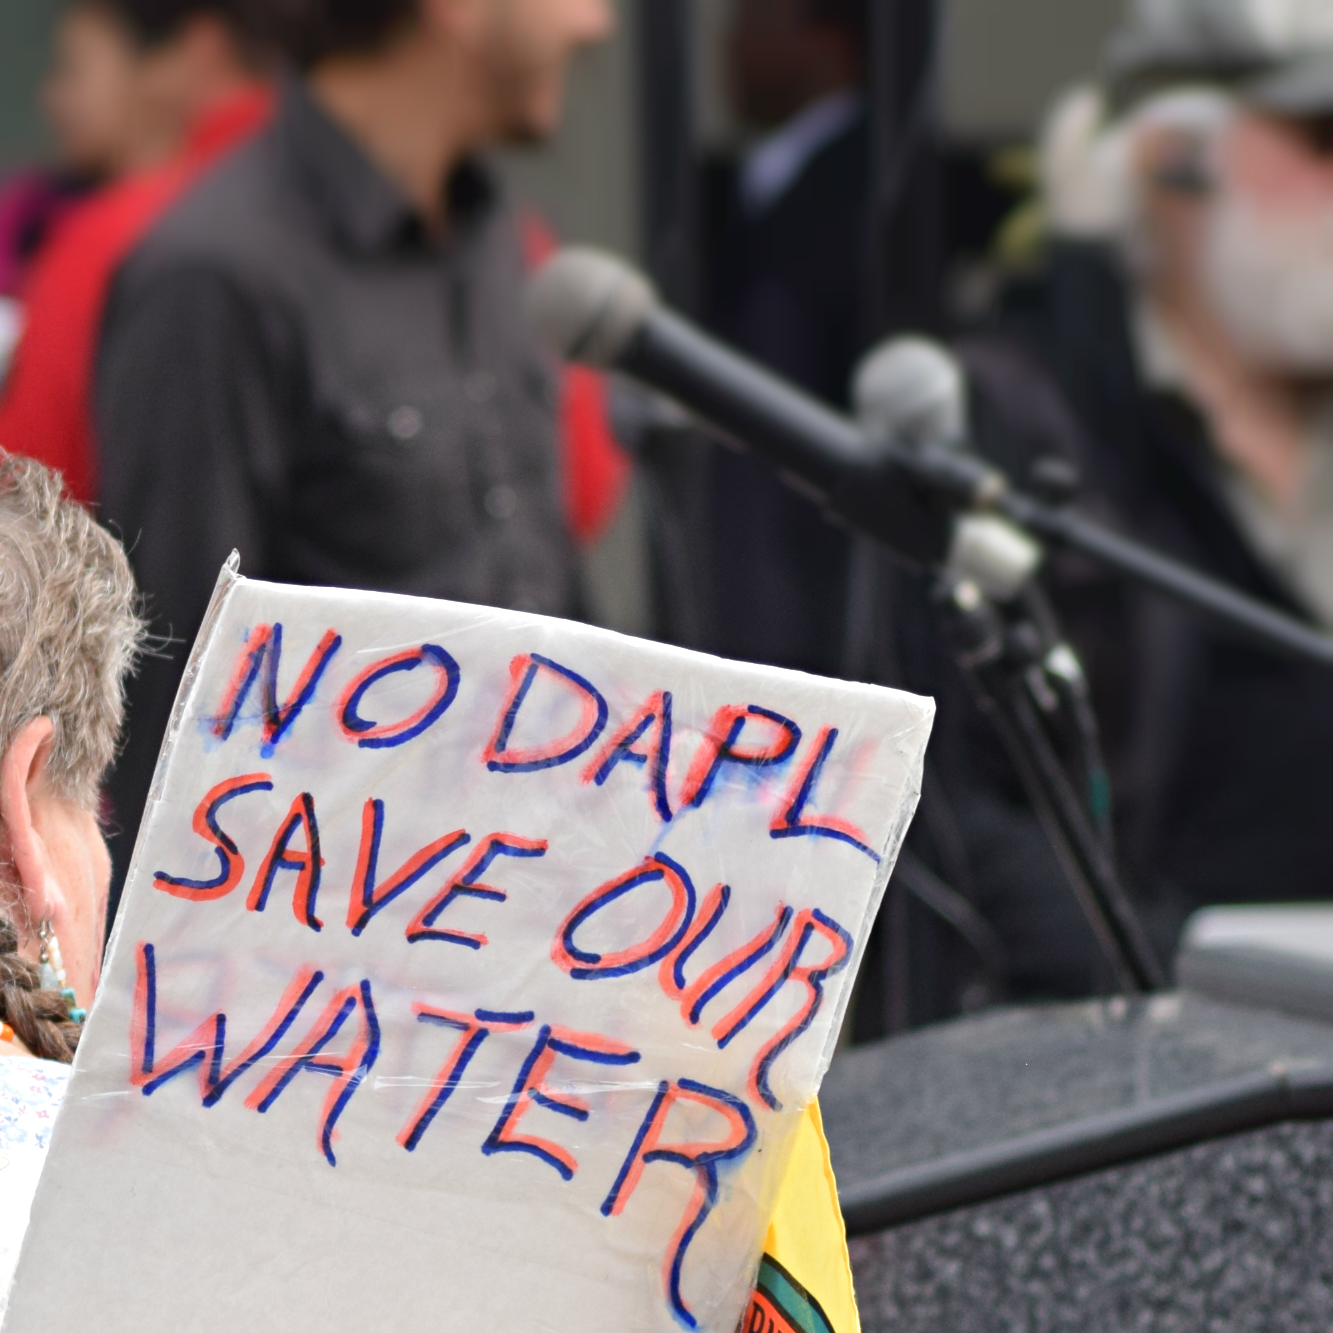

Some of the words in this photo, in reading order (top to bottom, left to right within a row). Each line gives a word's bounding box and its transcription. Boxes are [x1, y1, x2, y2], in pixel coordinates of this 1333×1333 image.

[204, 621, 461, 756] NO
[483, 652, 882, 863] DAPL
[153, 772, 549, 951] SAVE
[550, 851, 854, 1112] OUR
[129, 942, 758, 1332] WATER
